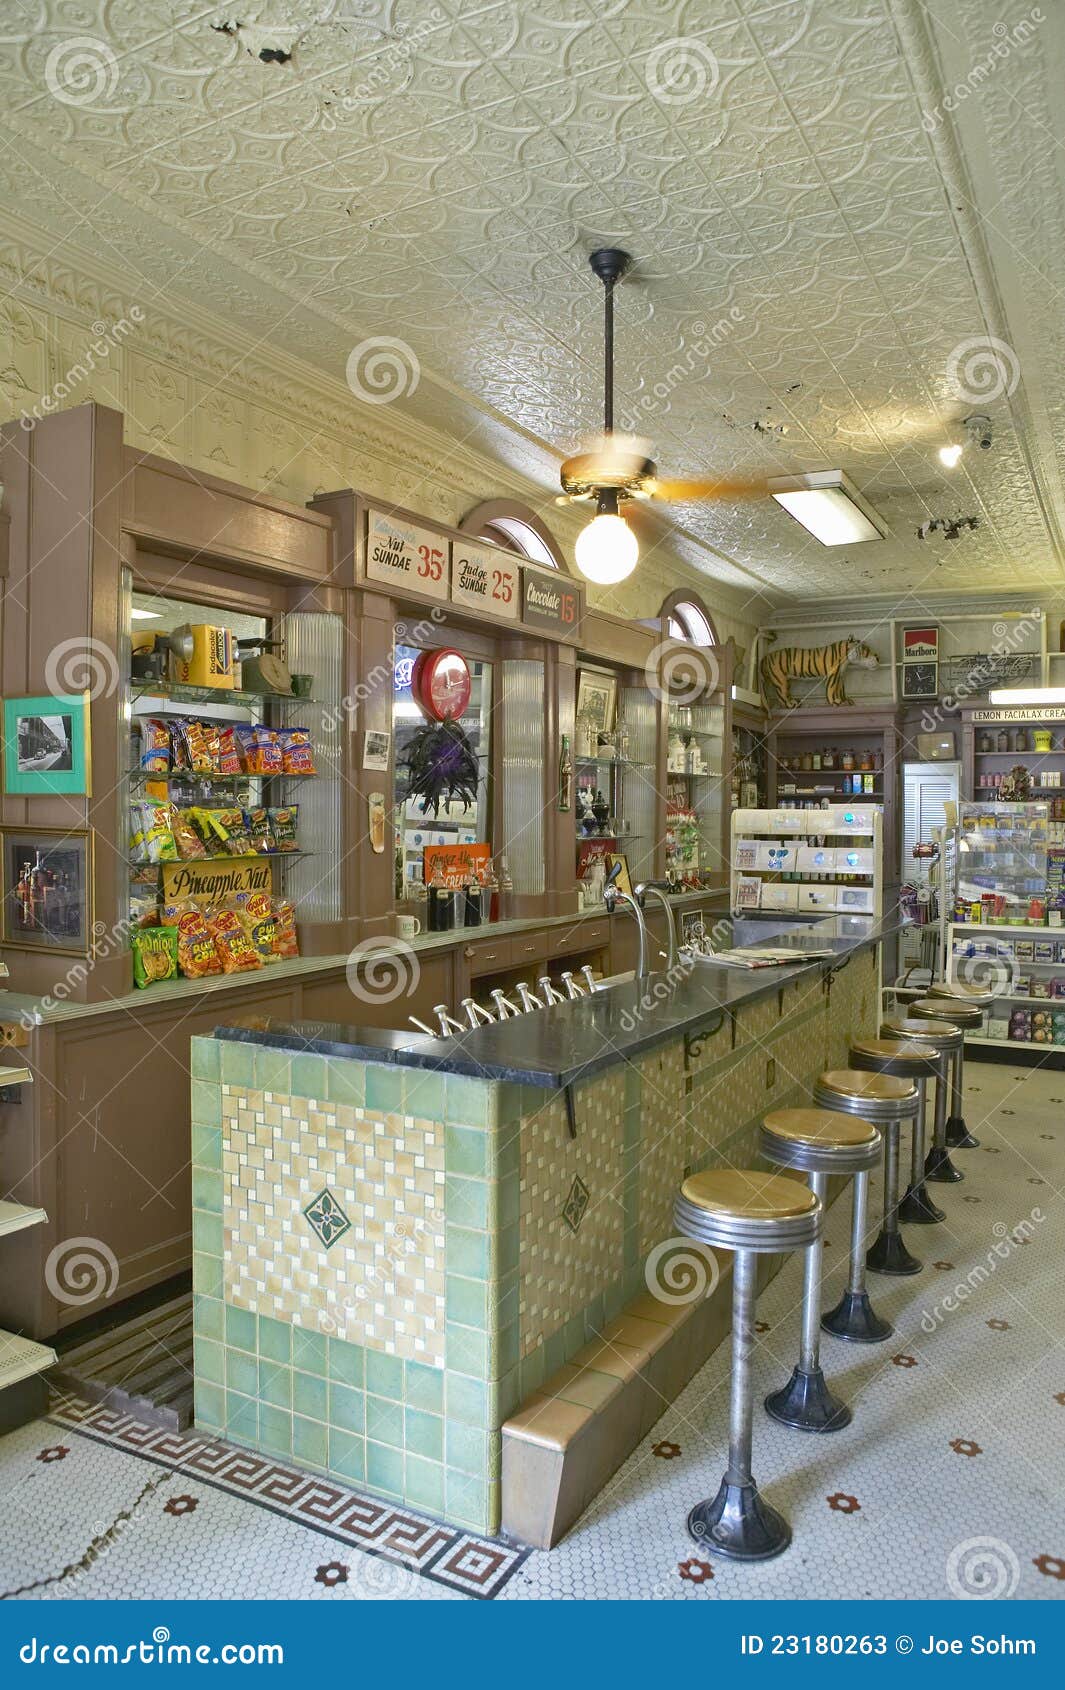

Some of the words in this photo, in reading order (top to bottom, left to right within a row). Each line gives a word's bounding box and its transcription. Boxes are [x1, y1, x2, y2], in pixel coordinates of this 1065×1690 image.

[372, 547, 412, 571] SUNDAE
[458, 559, 488, 580] Fudge
[459, 576, 488, 595] SUNDAE
[526, 582, 561, 610] Chocolate
[905, 646, 937, 657] Marlboro
[974, 711, 1001, 720] LEMON
[1004, 710, 1042, 719] FACIALAX
[169, 868, 243, 902] Pineapple
[241, 866, 270, 890] Nut
